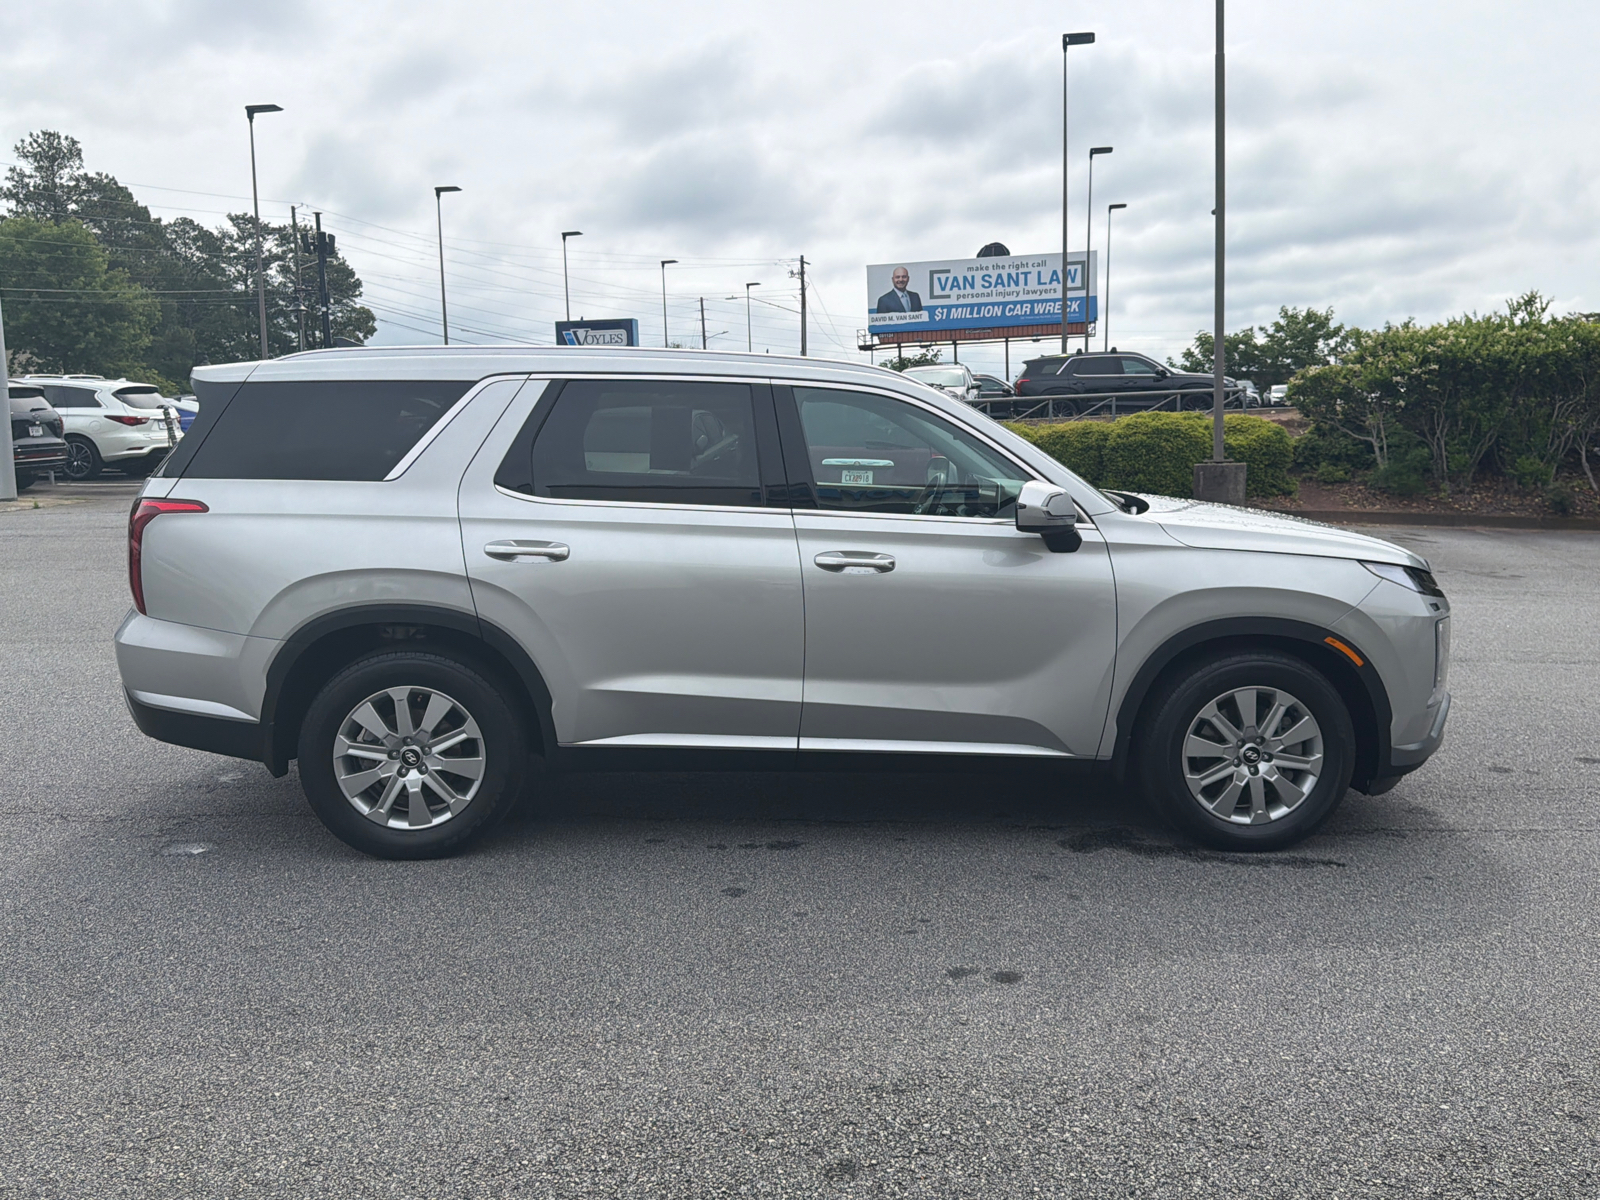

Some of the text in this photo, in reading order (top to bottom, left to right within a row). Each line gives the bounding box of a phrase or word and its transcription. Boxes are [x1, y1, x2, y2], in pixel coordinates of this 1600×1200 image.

[967, 259, 1047, 272] make the right call
[937, 268, 1078, 291] VAN SANT LAW
[956, 287, 1057, 301] personal injury lawyers
[934, 307, 948, 321] $1
[950, 305, 1003, 319] MILLION
[1005, 303, 1031, 316] CAR
[571, 330, 624, 346] VOYLES
